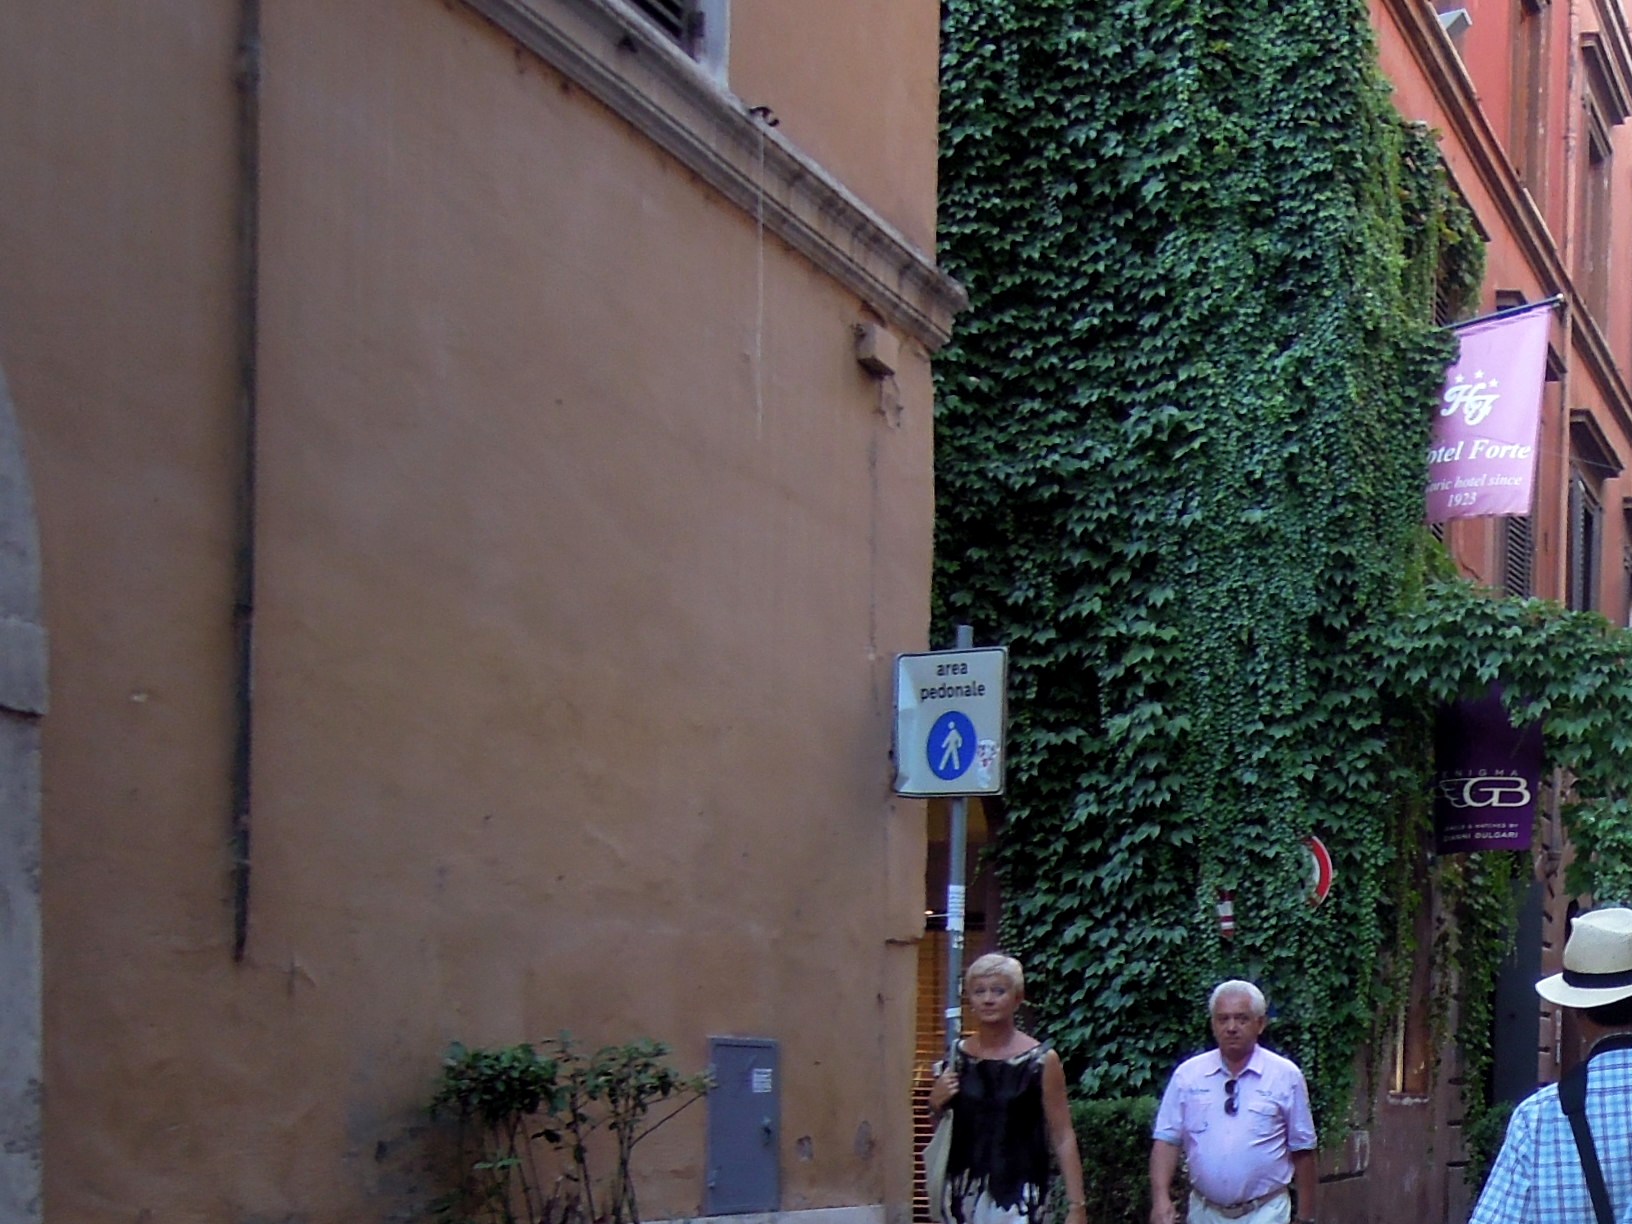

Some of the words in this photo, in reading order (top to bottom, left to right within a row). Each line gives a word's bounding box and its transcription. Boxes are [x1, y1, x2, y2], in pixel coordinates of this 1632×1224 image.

[1427, 439, 1464, 464] otel
[1468, 439, 1532, 460] Forte
[1454, 473, 1487, 488] hotel
[1488, 473, 1523, 486] since
[1447, 492, 1477, 507] 1923
[937, 663, 968, 676] area
[921, 681, 985, 702] pedonale
